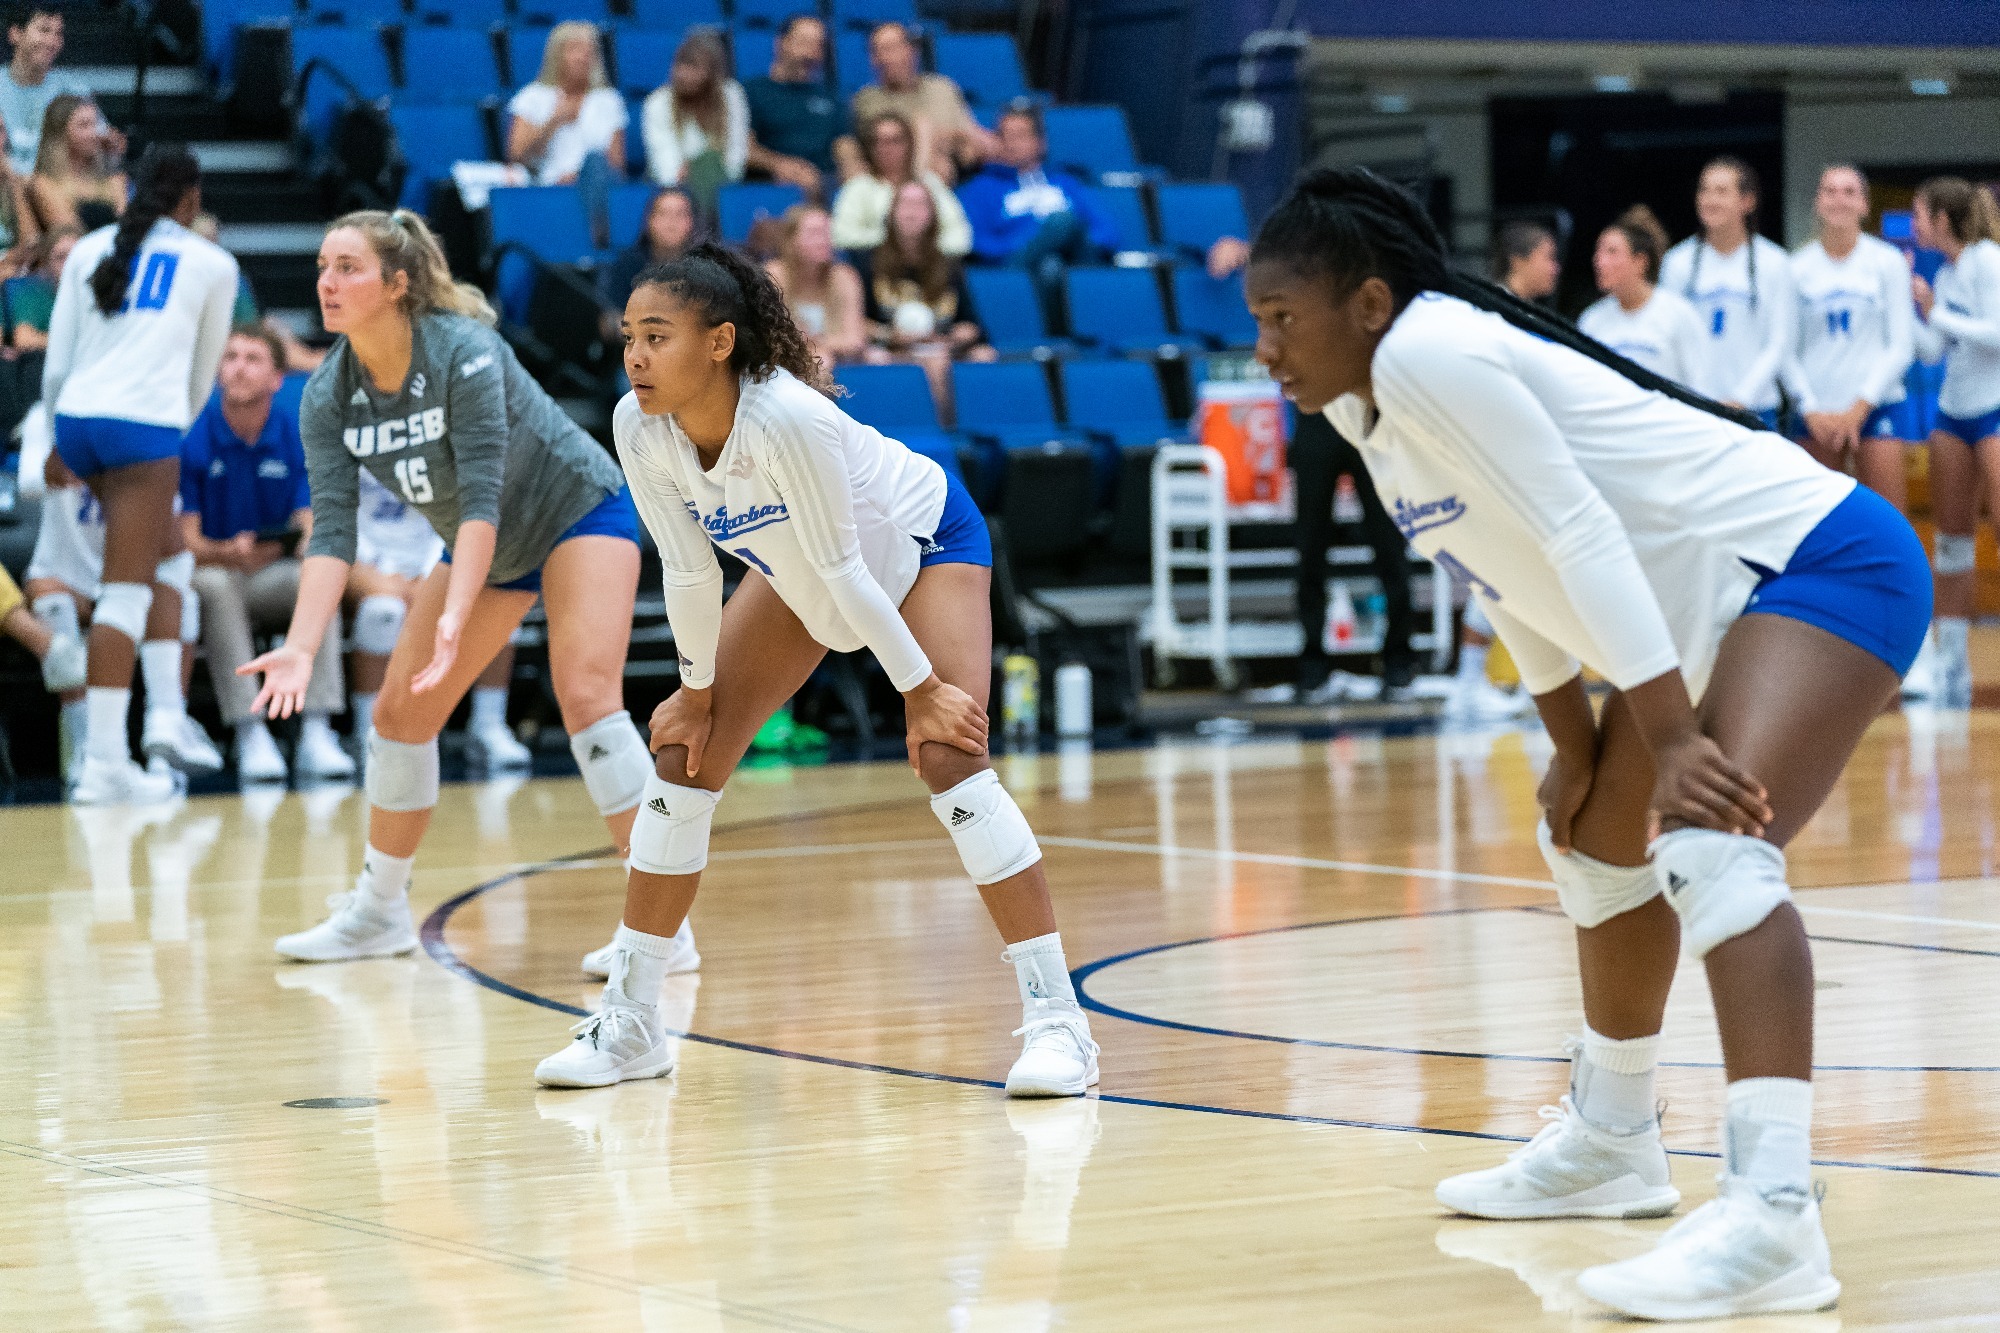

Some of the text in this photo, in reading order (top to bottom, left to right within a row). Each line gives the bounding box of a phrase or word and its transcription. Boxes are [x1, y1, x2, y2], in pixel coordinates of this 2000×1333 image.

[343, 406, 447, 457] UCSB
[394, 456, 434, 504] 15
[647, 802, 671, 817] adidas
[951, 811, 975, 827] adidas
